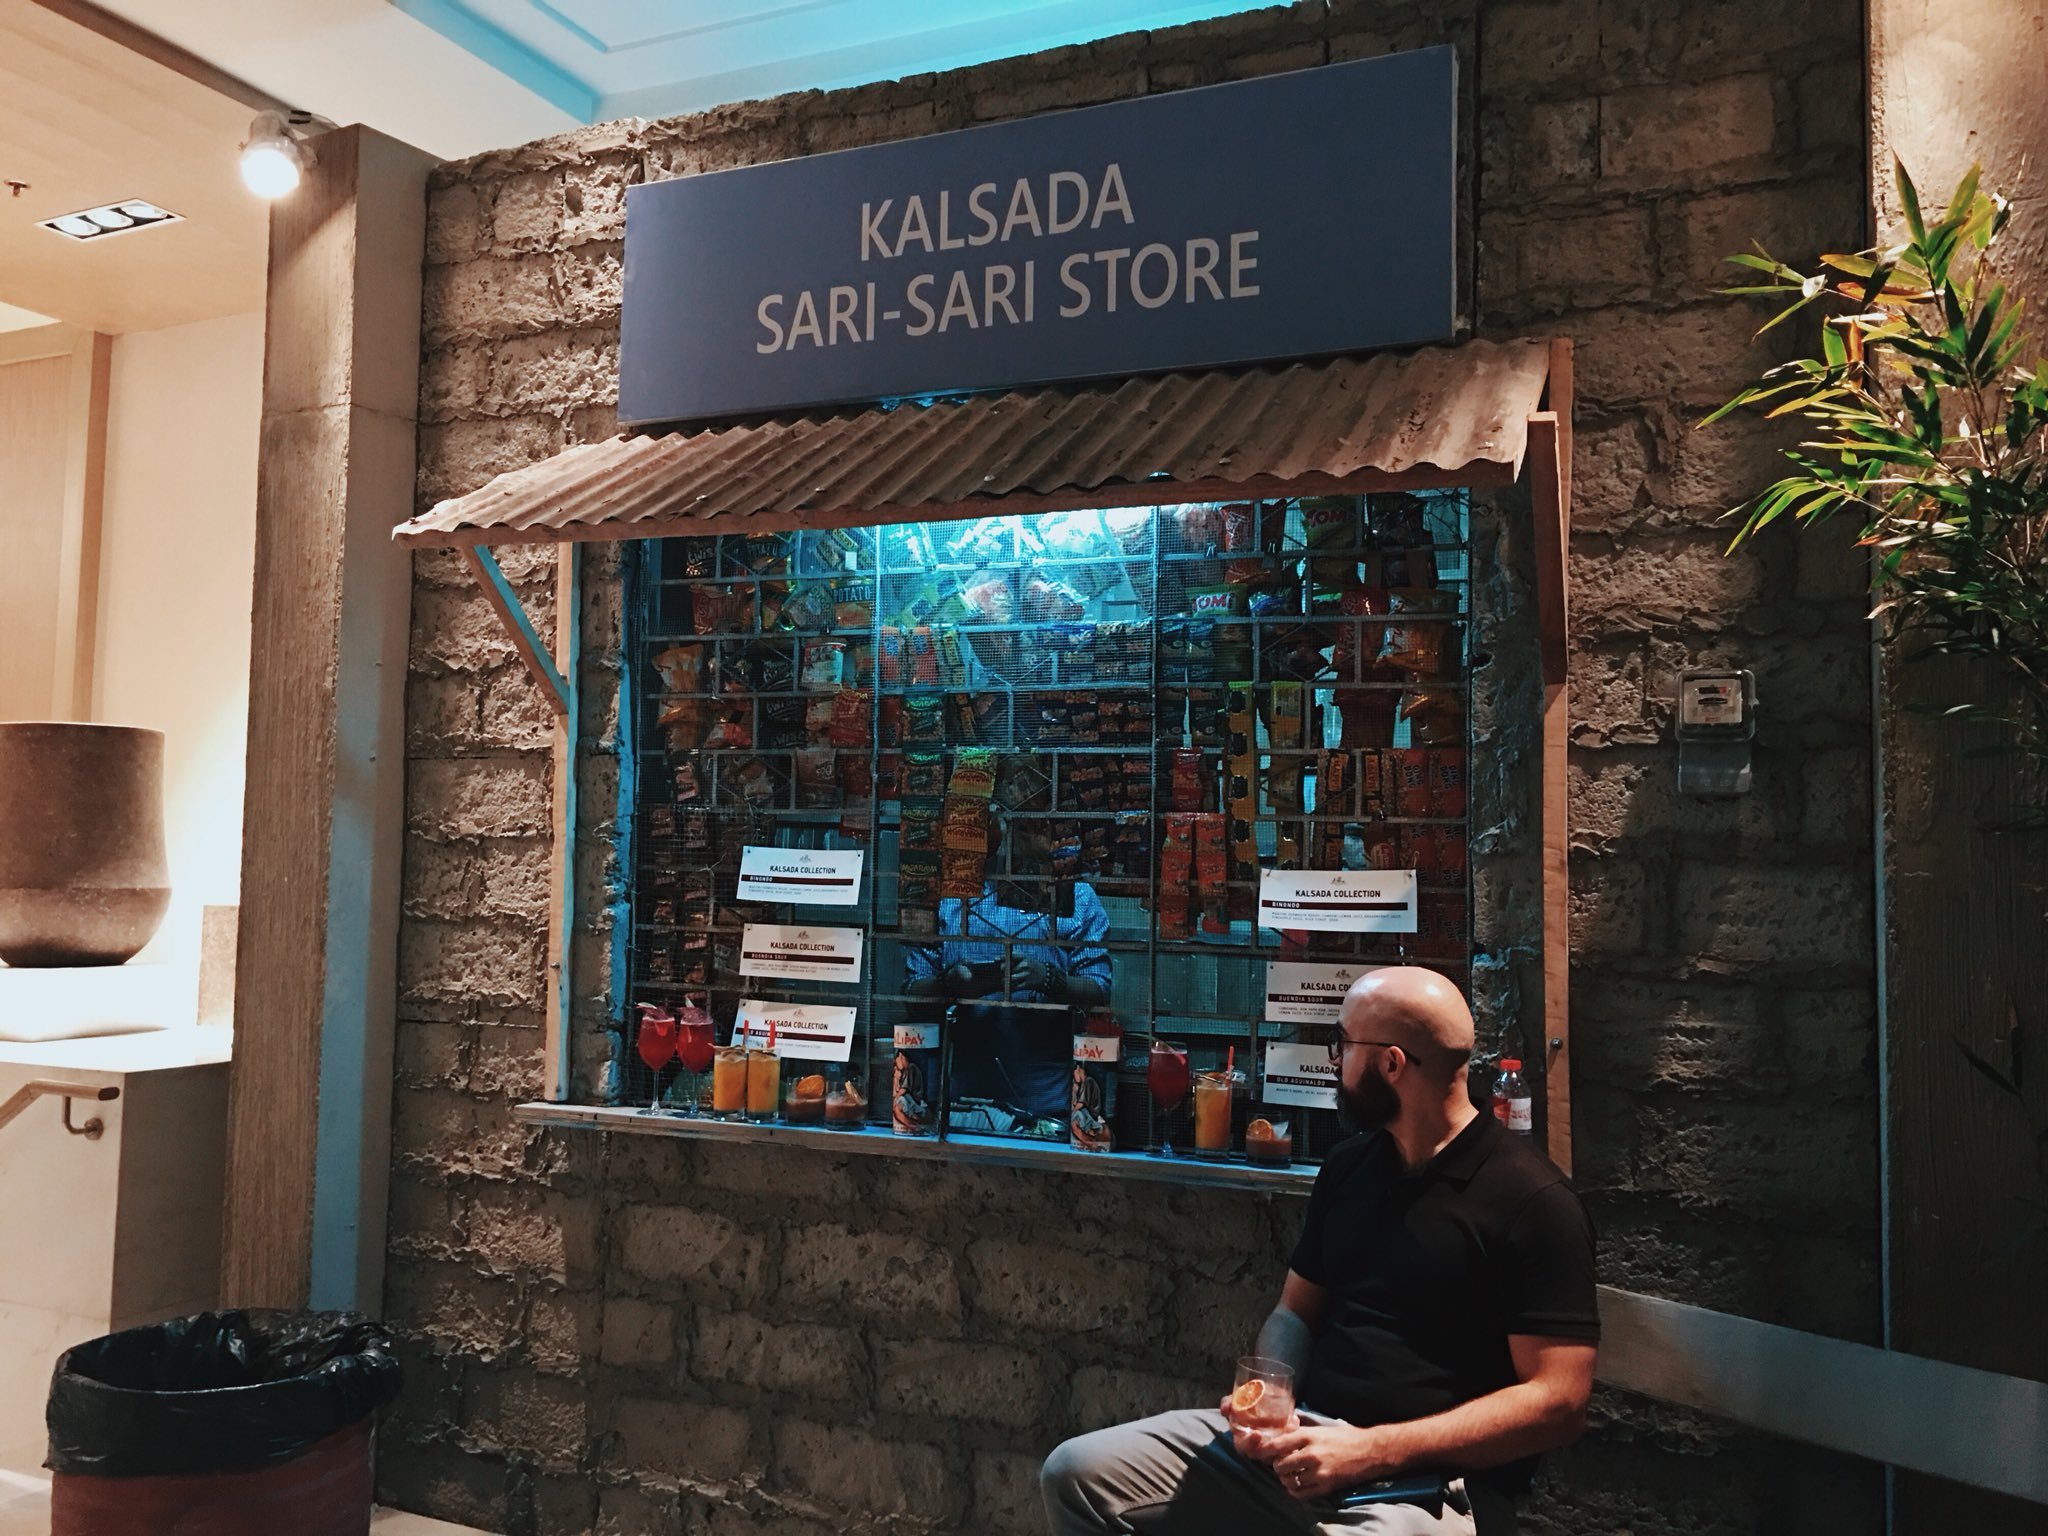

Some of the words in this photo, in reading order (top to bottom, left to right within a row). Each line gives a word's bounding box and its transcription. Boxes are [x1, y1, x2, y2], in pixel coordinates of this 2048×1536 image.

[859, 162, 1135, 262] KALSADA
[756, 259, 1035, 355] SARI-SARI
[1058, 230, 1261, 319] STORE
[833, 584, 871, 602] POTATO
[1404, 765, 1416, 788] DONG
[770, 865, 799, 873] KALSADA
[800, 866, 837, 874] COLLECTION
[1295, 889, 1331, 898] KALSADA
[1333, 890, 1381, 898] COLLECTION
[1271, 901, 1300, 909] BINONDO
[770, 941, 798, 950] KALSADA
[799, 943, 835, 952] COLLECTION
[1300, 982, 1337, 992] KALSADA
[1278, 995, 1306, 1003] BUENDIA
[764, 1019, 793, 1028] KASADA
[793, 1021, 828, 1030] COLLECTION
[1299, 1064, 1337, 1075] KALSADA
